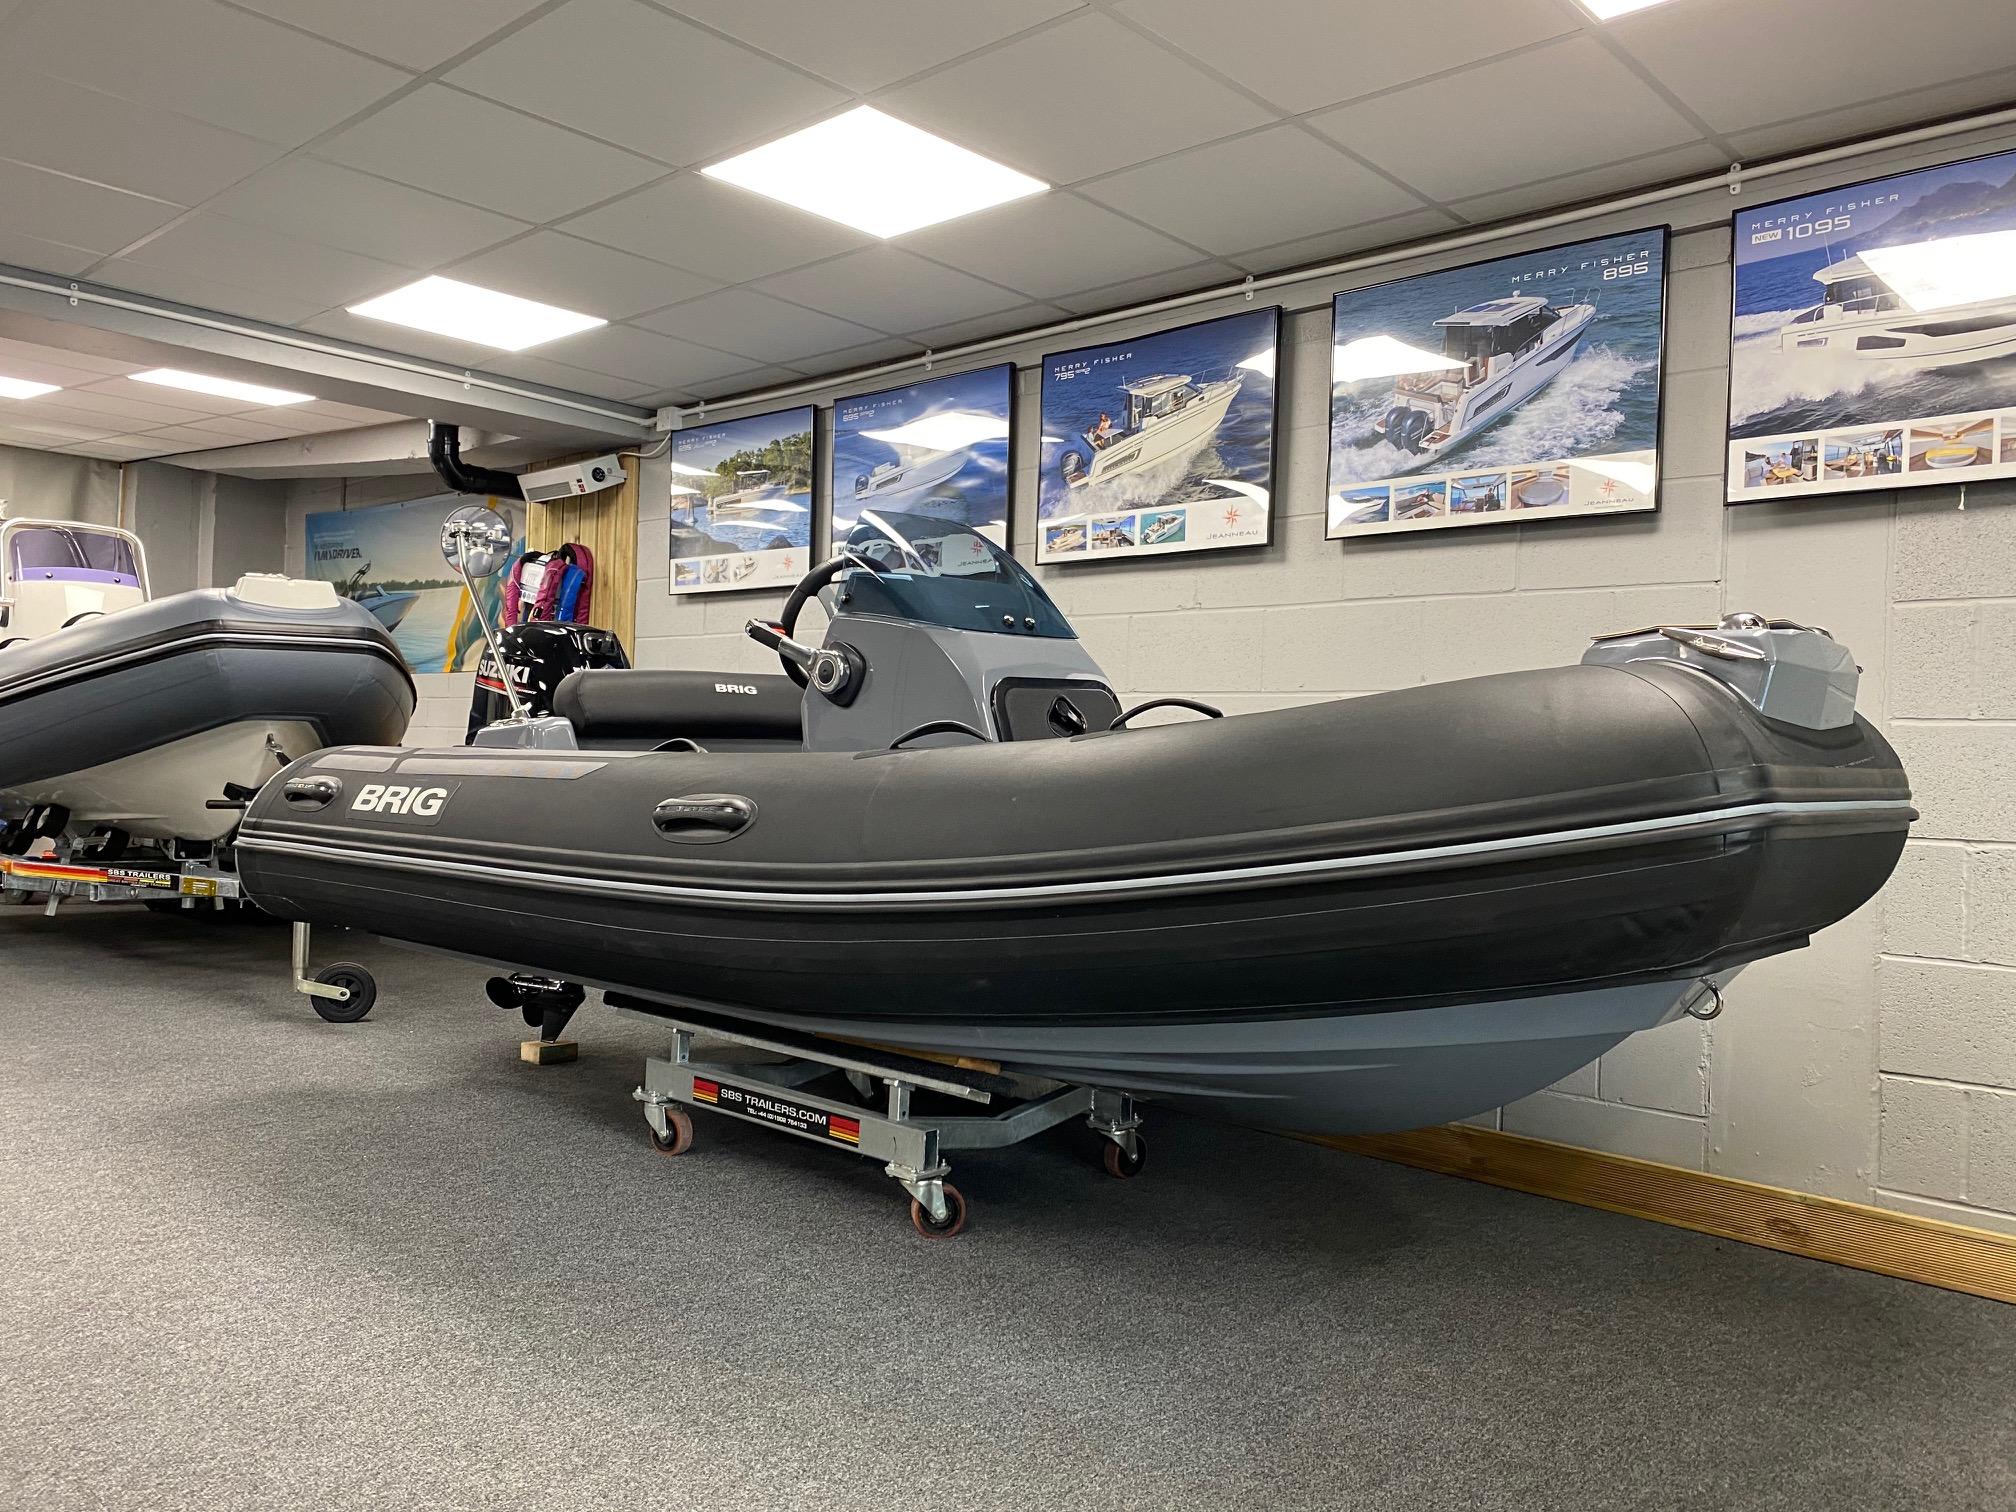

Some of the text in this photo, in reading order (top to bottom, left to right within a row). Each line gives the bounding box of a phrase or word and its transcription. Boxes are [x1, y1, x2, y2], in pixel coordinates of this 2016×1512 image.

[1751, 193, 1899, 230] MERRY FISHER
[1754, 215, 1851, 242] NEW 1095
[1511, 250, 1649, 284] MERRY FISHER
[1603, 261, 1649, 280] 895
[1054, 353, 1132, 373] MERRY FISHER
[1054, 370, 1075, 382] 795
[1206, 529, 1258, 540] JEANNEAU
[957, 558, 994, 568] JEANNEA
[714, 683, 758, 695] BRIG
[351, 784, 448, 816] BRIG
[107, 868, 171, 881] SBS TRAILERS
[721, 1088, 827, 1126] SBS TRAILERS.COM
